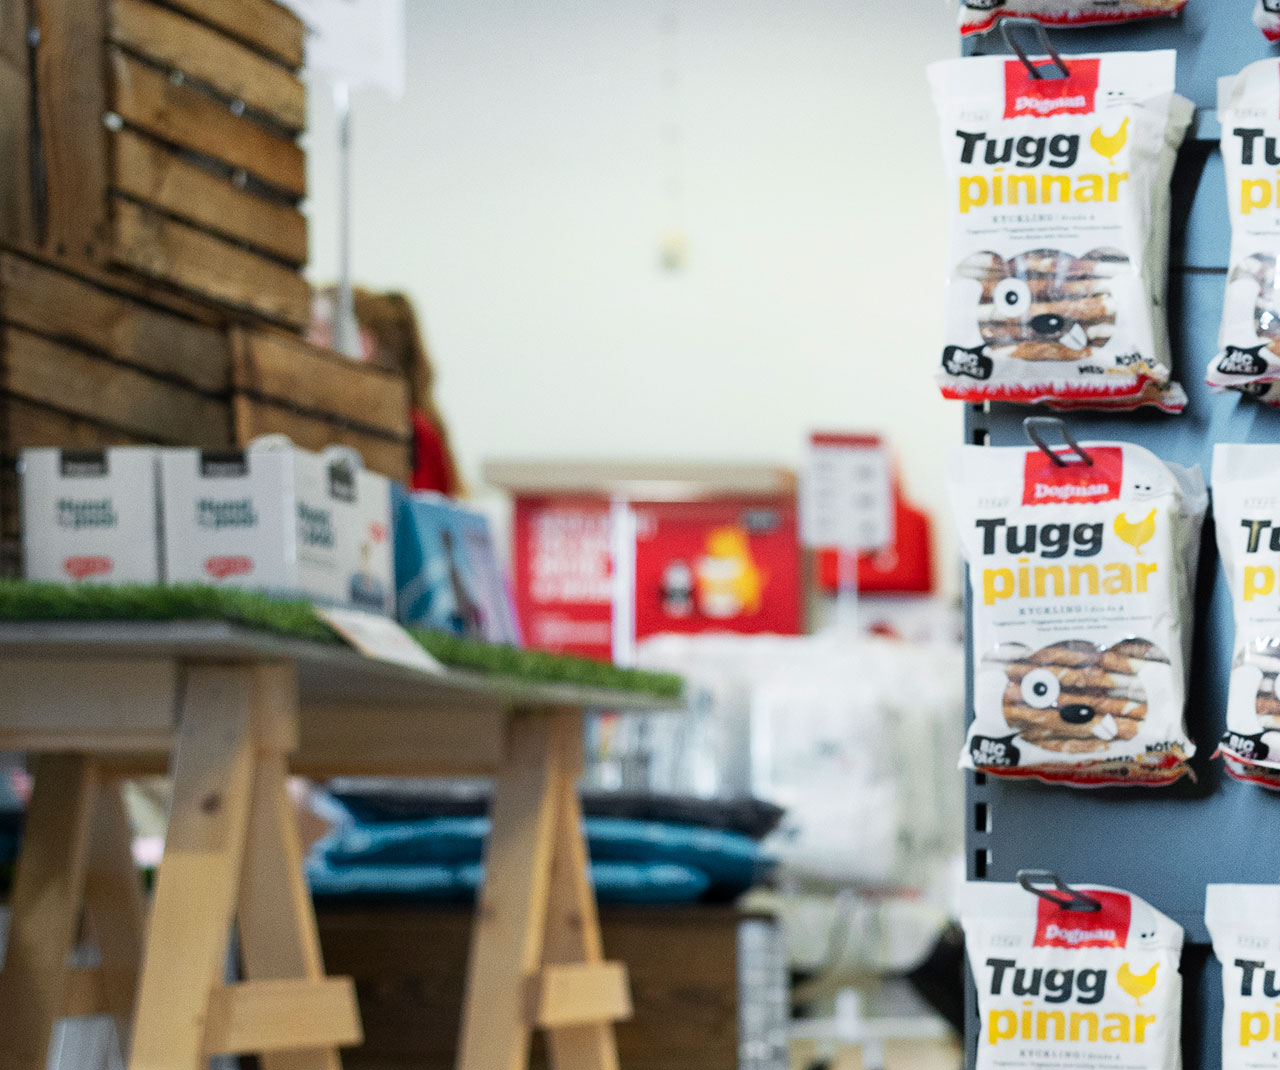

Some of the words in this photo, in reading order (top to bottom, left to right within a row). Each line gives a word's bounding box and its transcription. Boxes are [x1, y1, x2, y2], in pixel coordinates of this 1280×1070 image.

[955, 130, 1080, 168] Tugg
[959, 168, 1130, 214] pinnar
[1034, 482, 1110, 499] Dogman
[975, 518, 1104, 558] Tugg
[983, 558, 1158, 605] pinnar
[986, 957, 1107, 1004] Tugg
[988, 1001, 1157, 1046] pinnar
